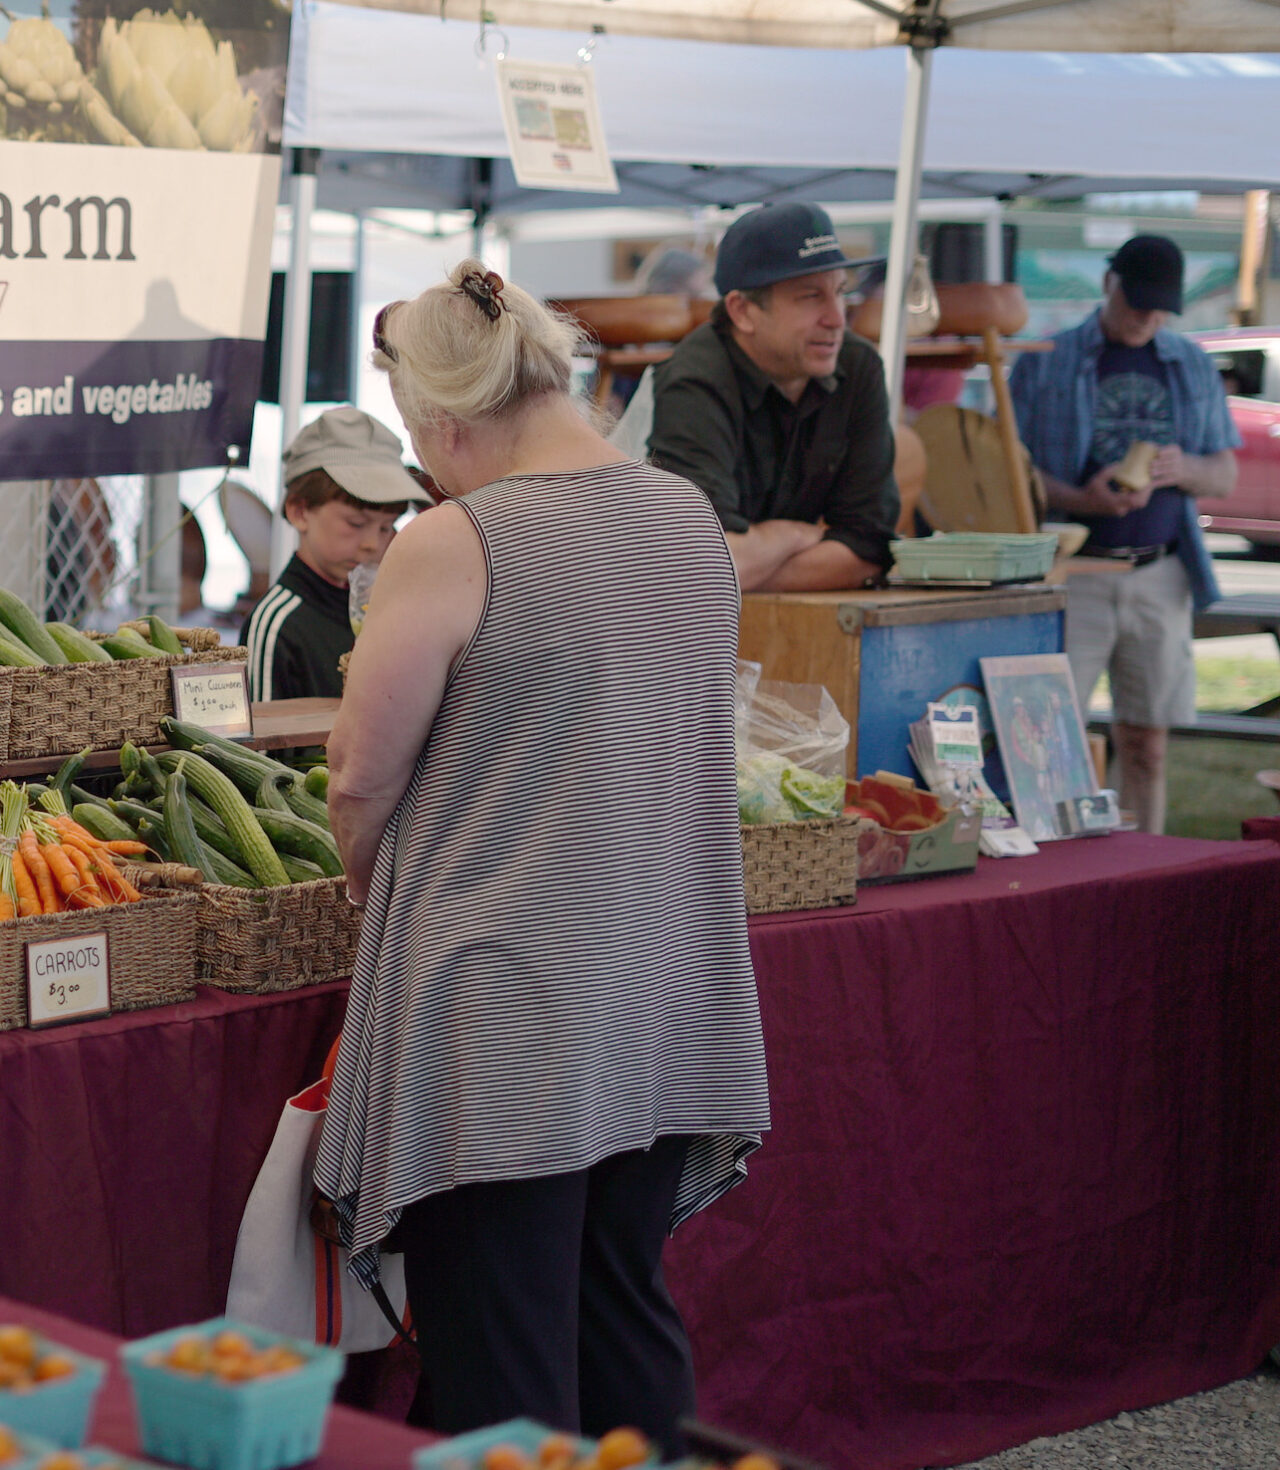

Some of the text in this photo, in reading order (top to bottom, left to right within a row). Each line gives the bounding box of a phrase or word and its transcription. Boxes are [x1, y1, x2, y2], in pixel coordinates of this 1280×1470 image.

[12, 375, 74, 417] and
[83, 374, 213, 424] vegetables
[35, 946, 100, 976] CARROTS
